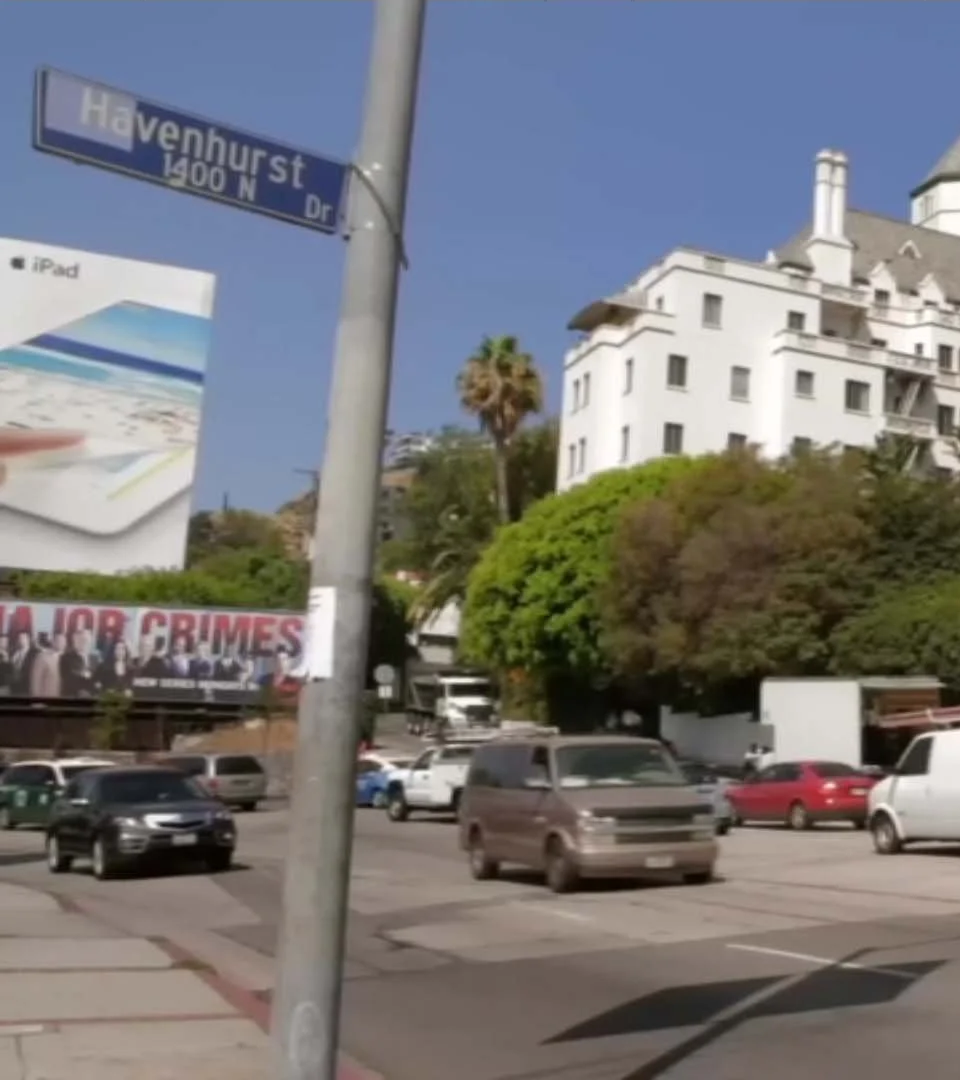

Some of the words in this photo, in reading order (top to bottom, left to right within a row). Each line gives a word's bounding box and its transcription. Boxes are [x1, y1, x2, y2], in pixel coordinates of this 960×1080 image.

[79, 85, 305, 189] Havenhurst
[163, 152, 227, 193] 1400
[237, 175, 256, 202] N
[305, 193, 333, 222] Dr
[31, 256, 80, 280] iPad
[0, 605, 129, 654] AJOR
[140, 610, 303, 660] CRIMES
